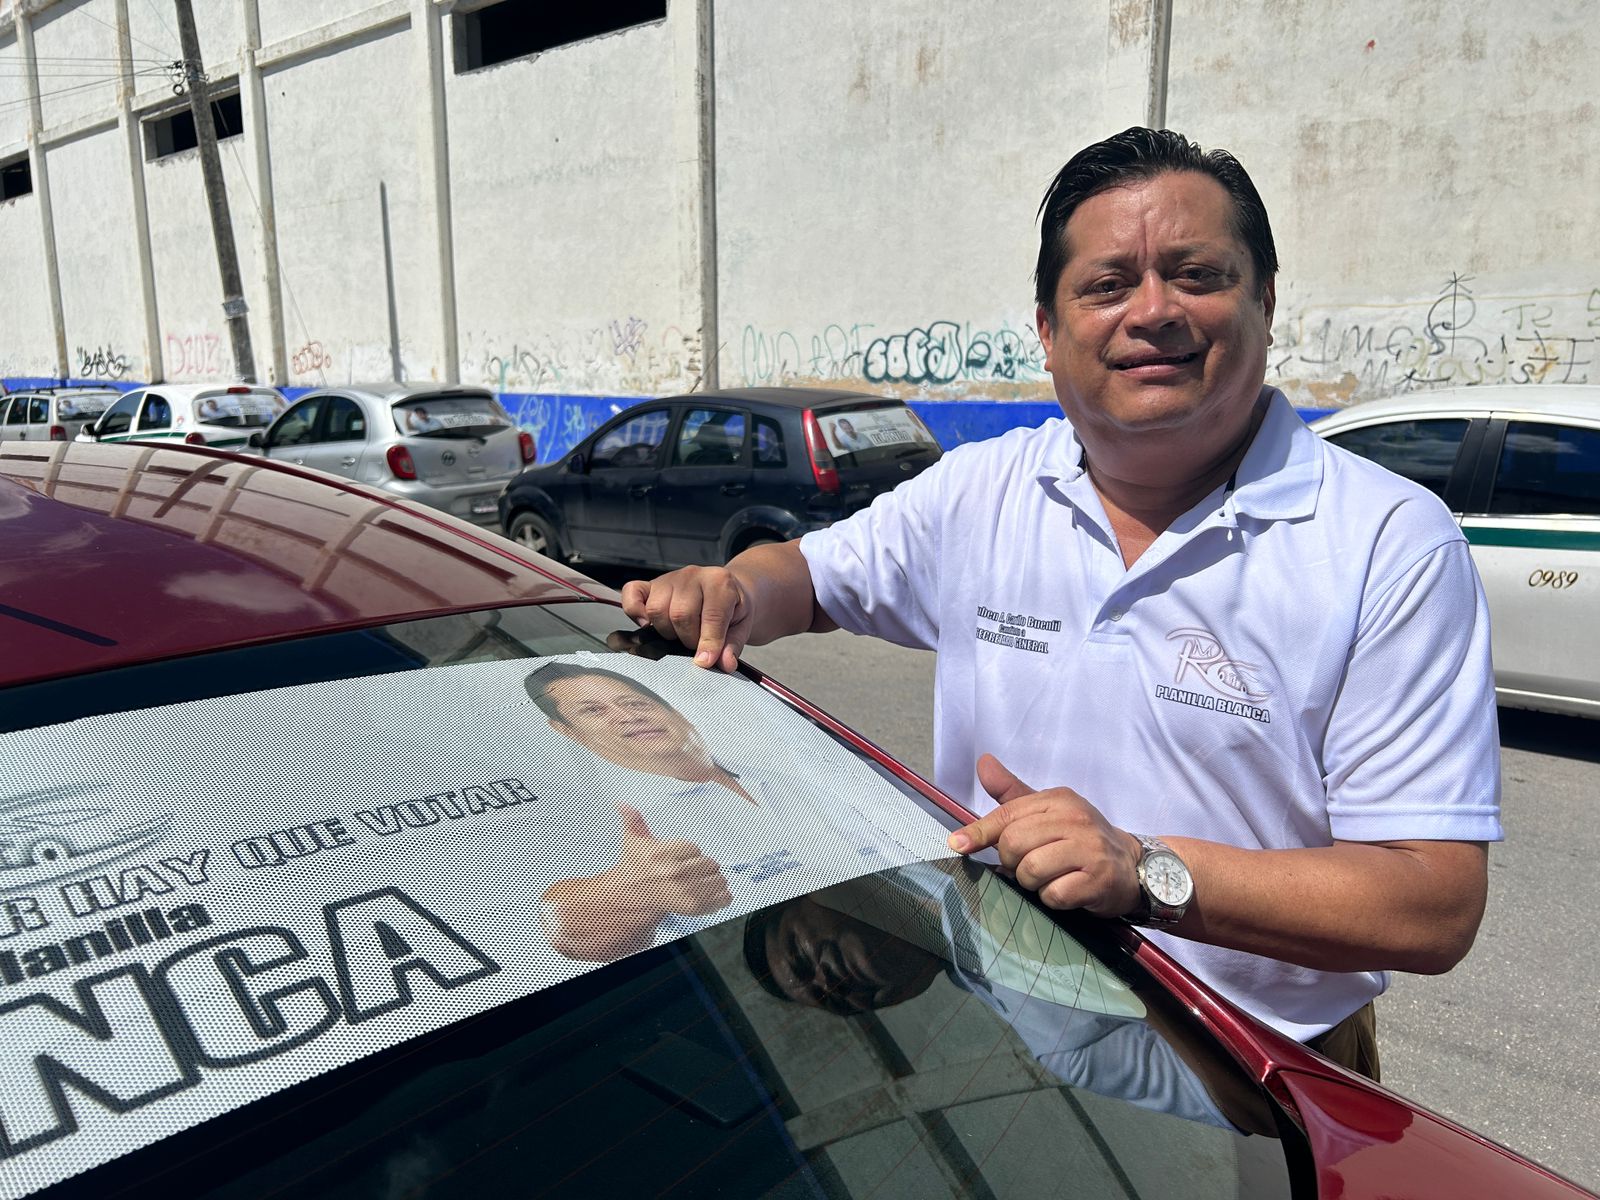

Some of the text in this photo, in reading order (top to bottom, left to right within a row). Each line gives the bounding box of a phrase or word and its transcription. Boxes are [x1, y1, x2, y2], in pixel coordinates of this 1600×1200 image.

[1528, 569, 1578, 589] 0989
[1014, 636, 1049, 655] GENERAL
[1155, 684, 1271, 723] PLANILLA BLANCA
[61, 849, 211, 918] HAY
[231, 817, 357, 869] QUE
[354, 777, 539, 836] VOTAR
[0, 903, 213, 986] lanilla
